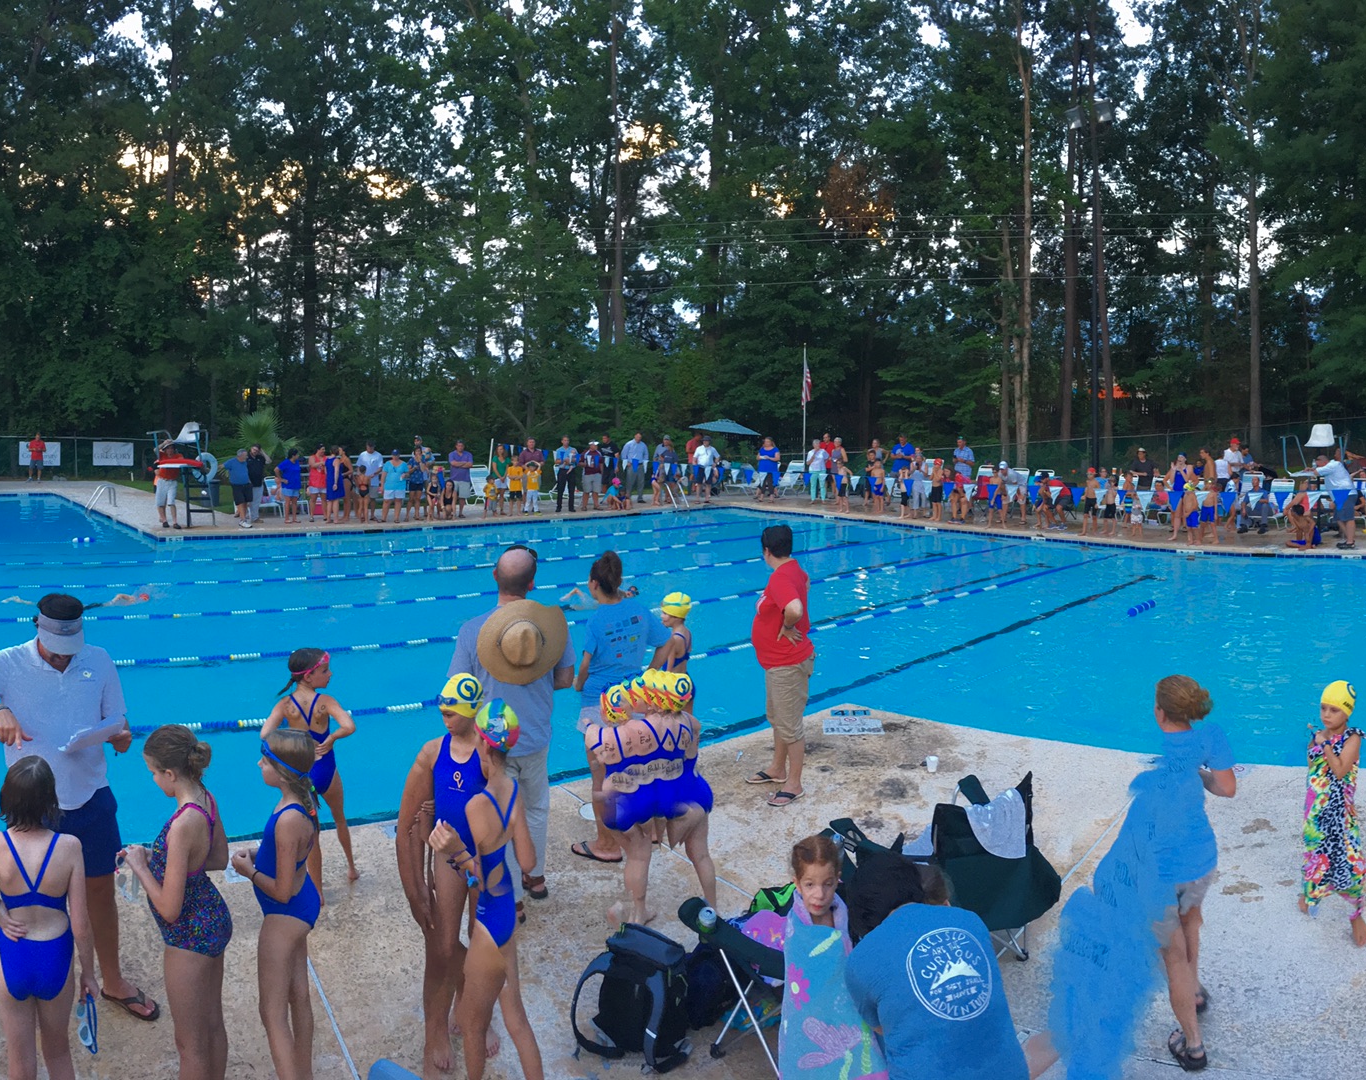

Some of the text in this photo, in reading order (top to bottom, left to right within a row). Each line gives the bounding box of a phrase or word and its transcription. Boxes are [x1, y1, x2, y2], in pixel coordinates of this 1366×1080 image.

[94, 452, 132, 460] GREGORY
[921, 949, 981, 979] CURIOUS
[929, 987, 943, 996] FOR
